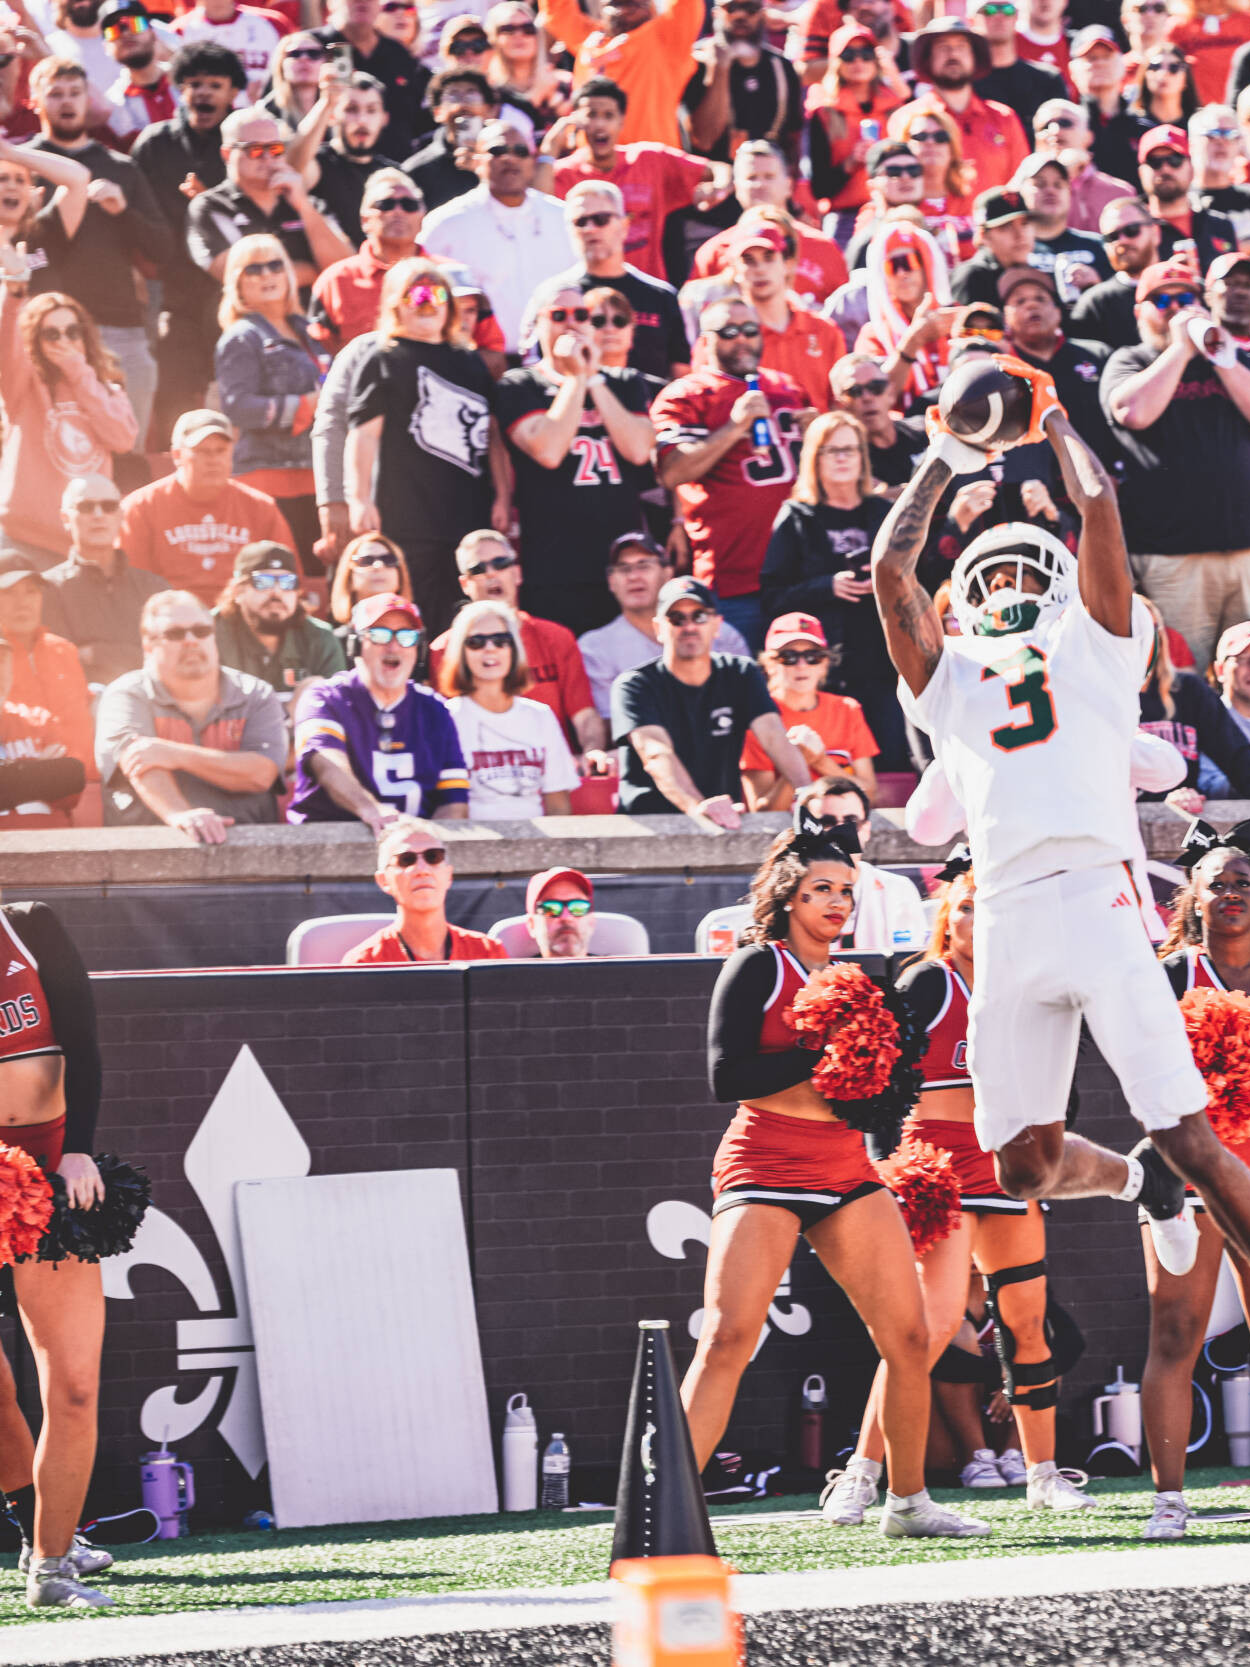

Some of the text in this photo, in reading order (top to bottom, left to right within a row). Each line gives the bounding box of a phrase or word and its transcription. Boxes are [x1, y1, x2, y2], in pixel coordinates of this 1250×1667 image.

[573, 436, 623, 484] 24
[969, 643, 1059, 753] 3
[373, 750, 423, 820] 5
